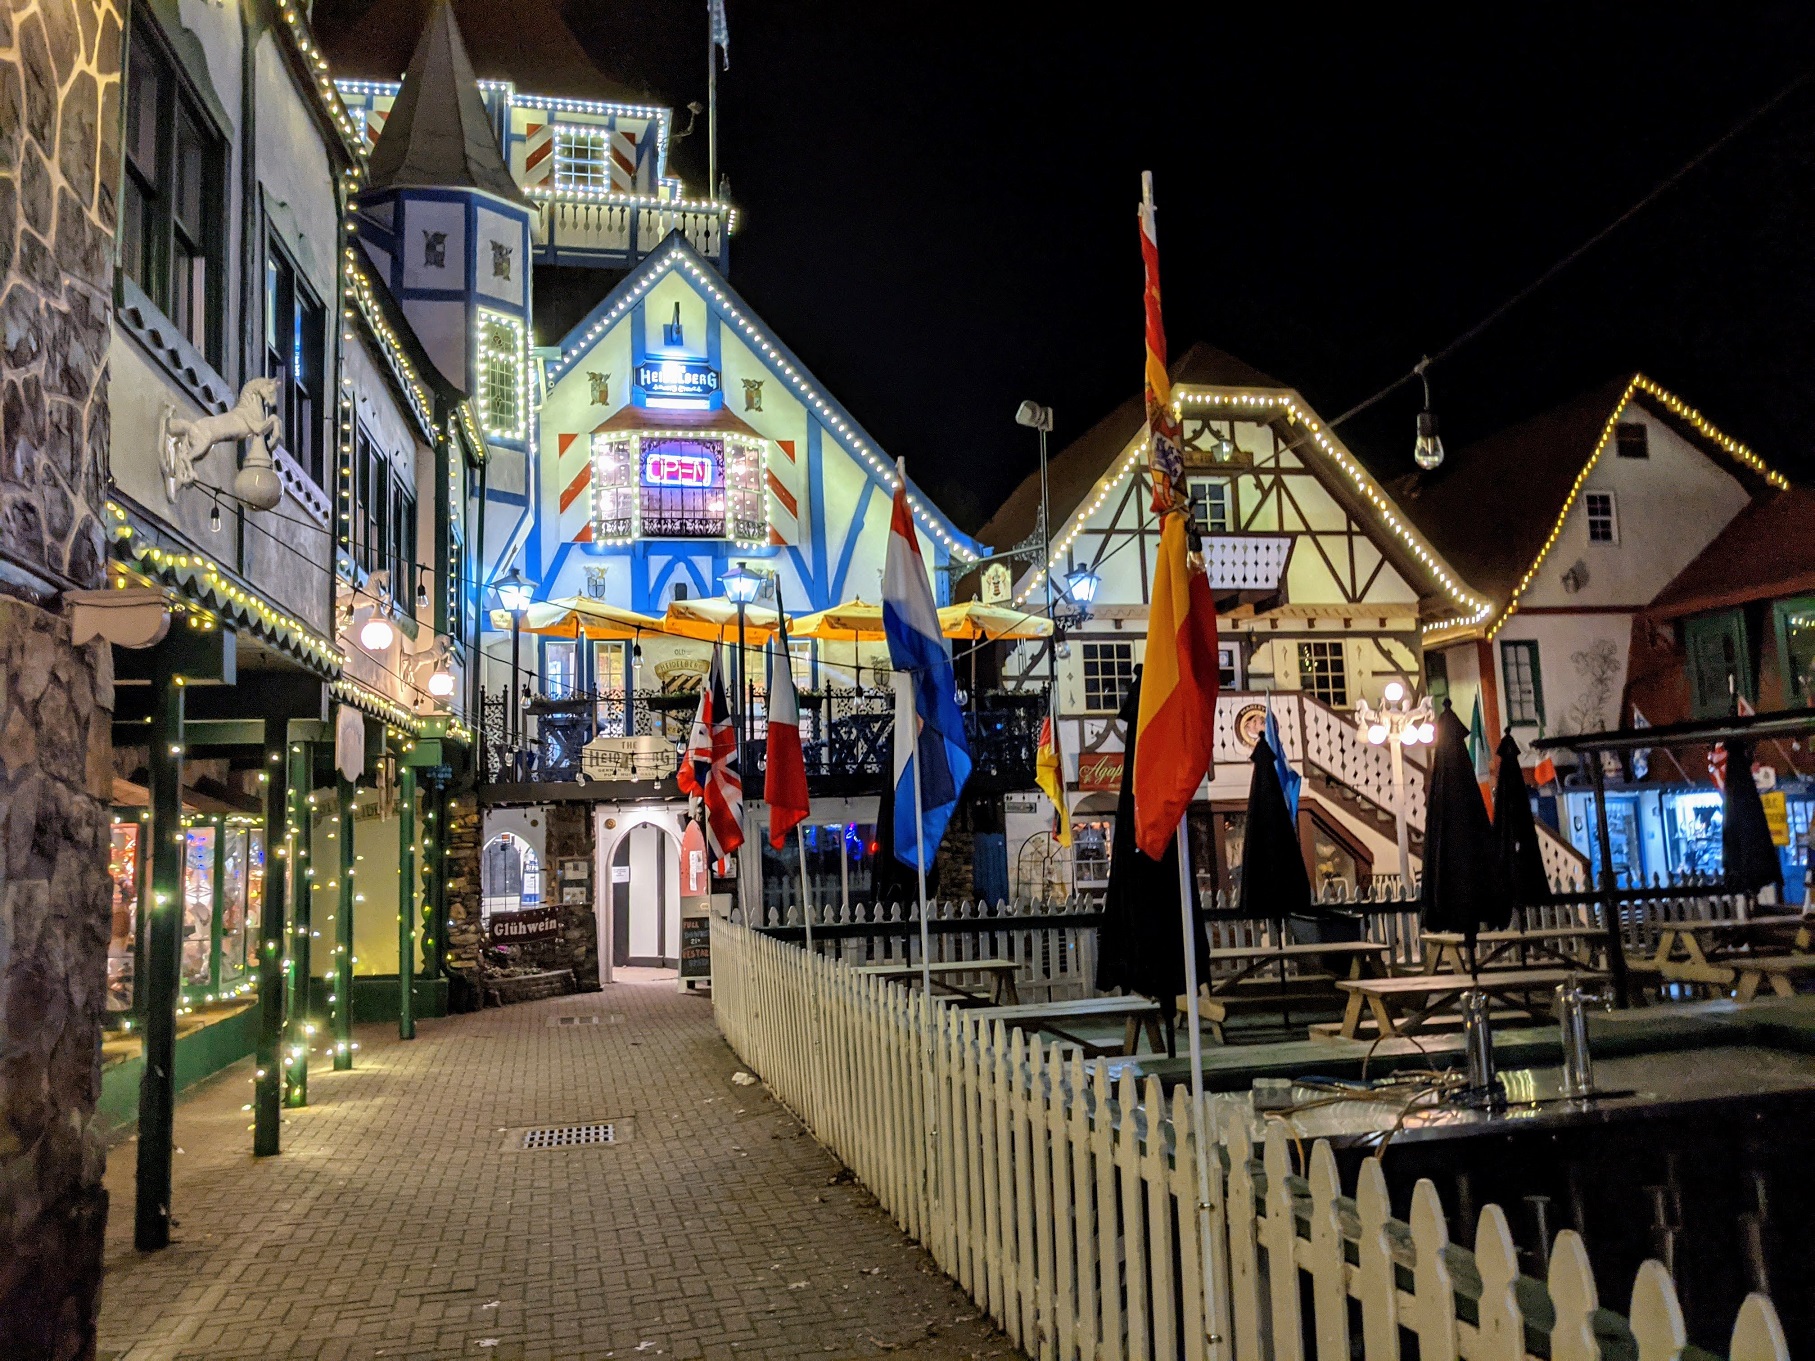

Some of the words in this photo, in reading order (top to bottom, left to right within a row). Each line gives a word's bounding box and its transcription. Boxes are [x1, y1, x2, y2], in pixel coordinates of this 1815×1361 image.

[640, 368, 717, 389] HEILBERG
[649, 458, 708, 483] OPEN
[621, 741, 638, 750] THE
[1079, 755, 1124, 784] Agap
[493, 917, 557, 936] Glühwein
